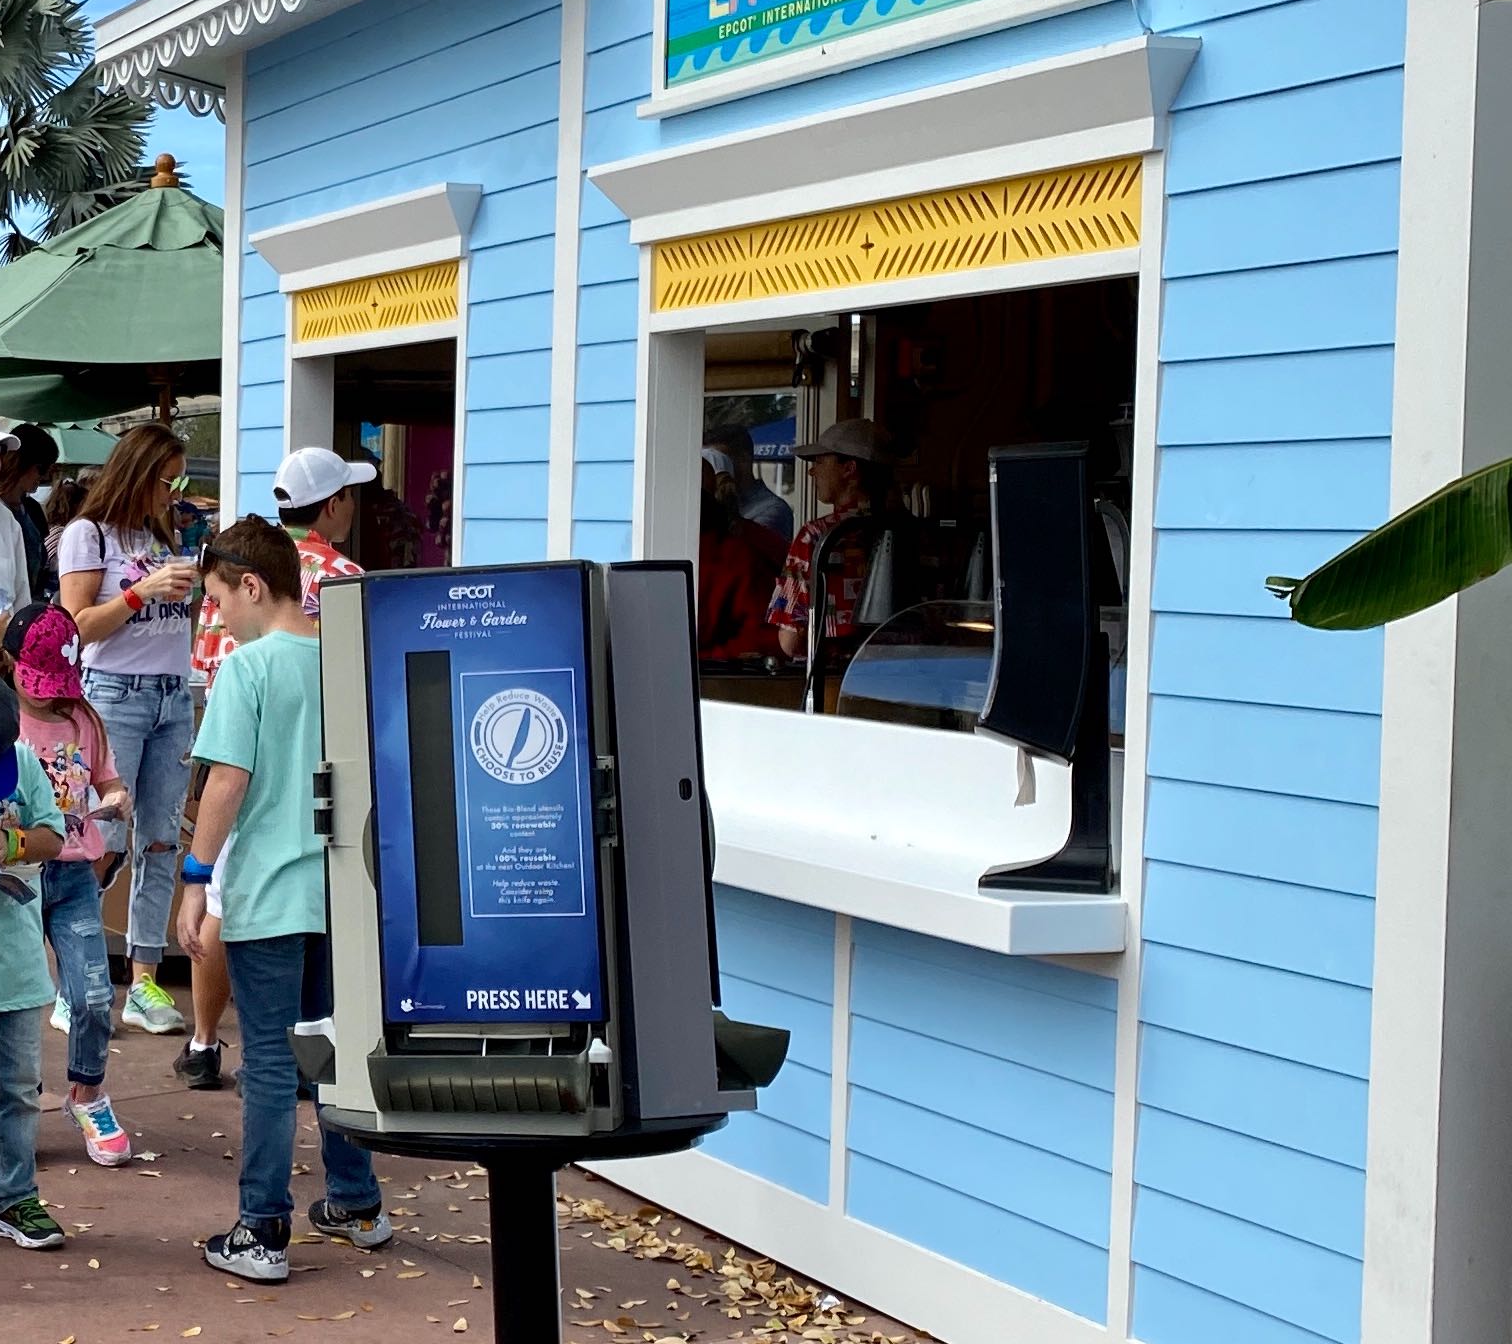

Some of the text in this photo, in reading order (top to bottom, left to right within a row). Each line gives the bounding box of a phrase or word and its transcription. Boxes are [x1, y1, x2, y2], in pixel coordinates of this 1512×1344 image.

[449, 584, 495, 599] EPCOT
[437, 601, 506, 611] INTERNATIONAL
[420, 610, 528, 630] Flower & Garden
[454, 630, 492, 639] FESTIVAL
[478, 690, 557, 722] Help Reduce Waste
[475, 743, 564, 782] CHOOSE TO REUSE
[511, 821, 556, 829] renewable
[519, 854, 557, 862] reusable
[466, 990, 520, 1009] PRESS
[525, 989, 569, 1009] HERE
